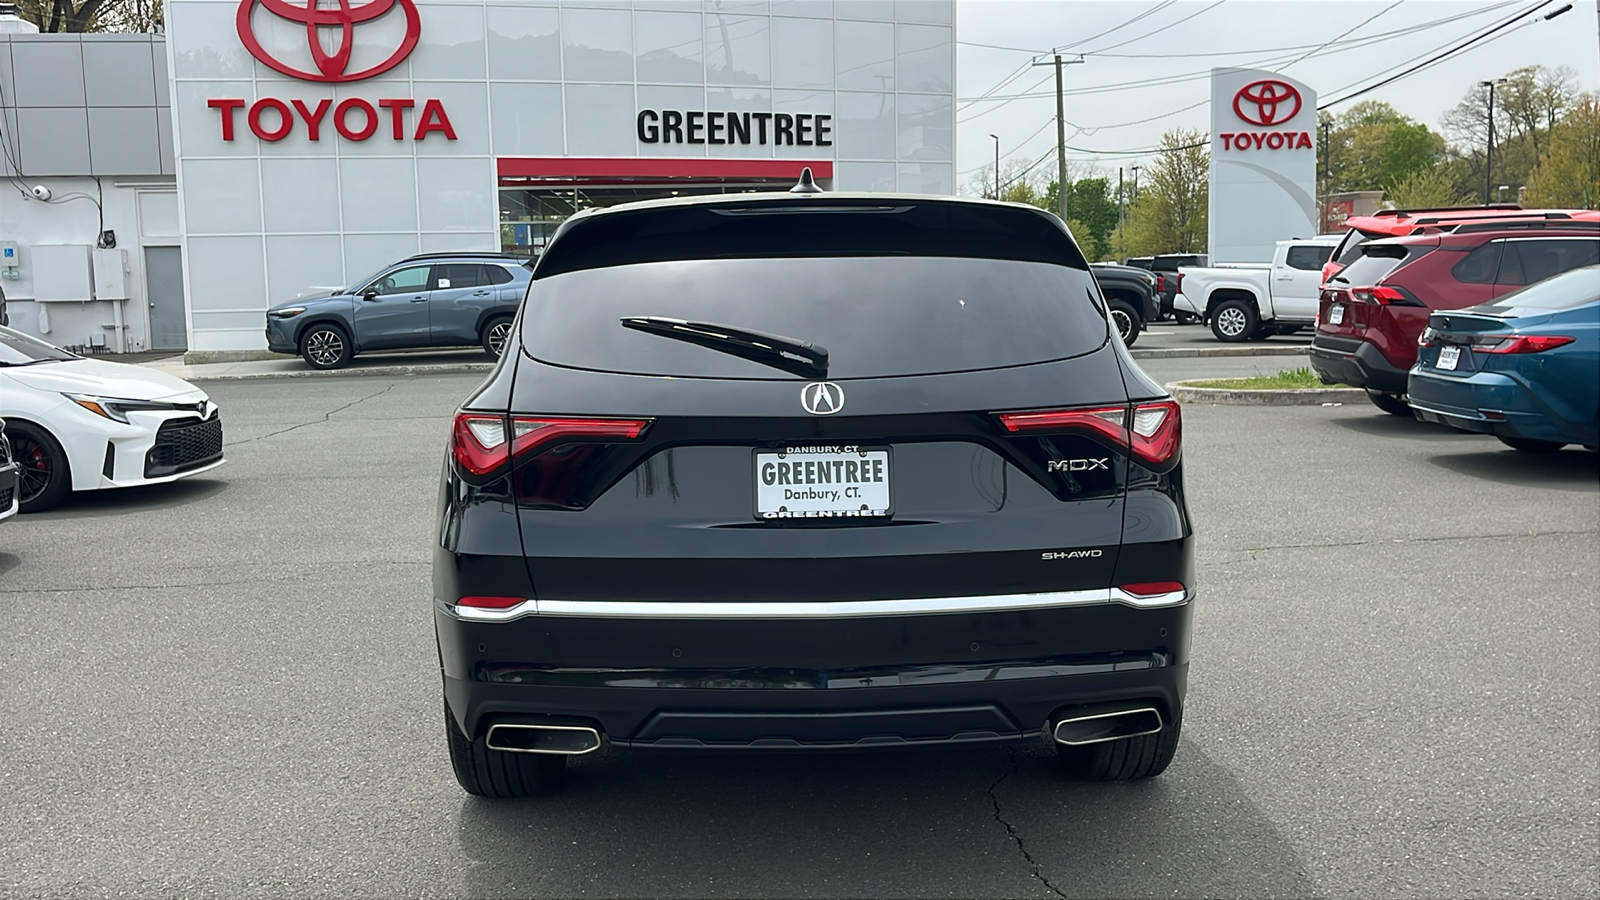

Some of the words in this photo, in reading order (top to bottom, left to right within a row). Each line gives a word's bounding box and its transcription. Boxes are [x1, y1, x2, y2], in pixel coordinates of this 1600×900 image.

[207, 98, 458, 142] TOYOTA
[637, 109, 833, 146] GREENTREE
[1220, 132, 1313, 151] TOYOTA
[786, 446, 841, 454] DANBURY,
[844, 445, 859, 453] CT
[1047, 457, 1109, 472] MDX
[761, 459, 883, 486] GREENTREE
[784, 487, 841, 502] Danbury,
[844, 487, 861, 498] CT.
[762, 509, 886, 519] GREENTREE
[1041, 549, 1103, 560] SH-AWD
